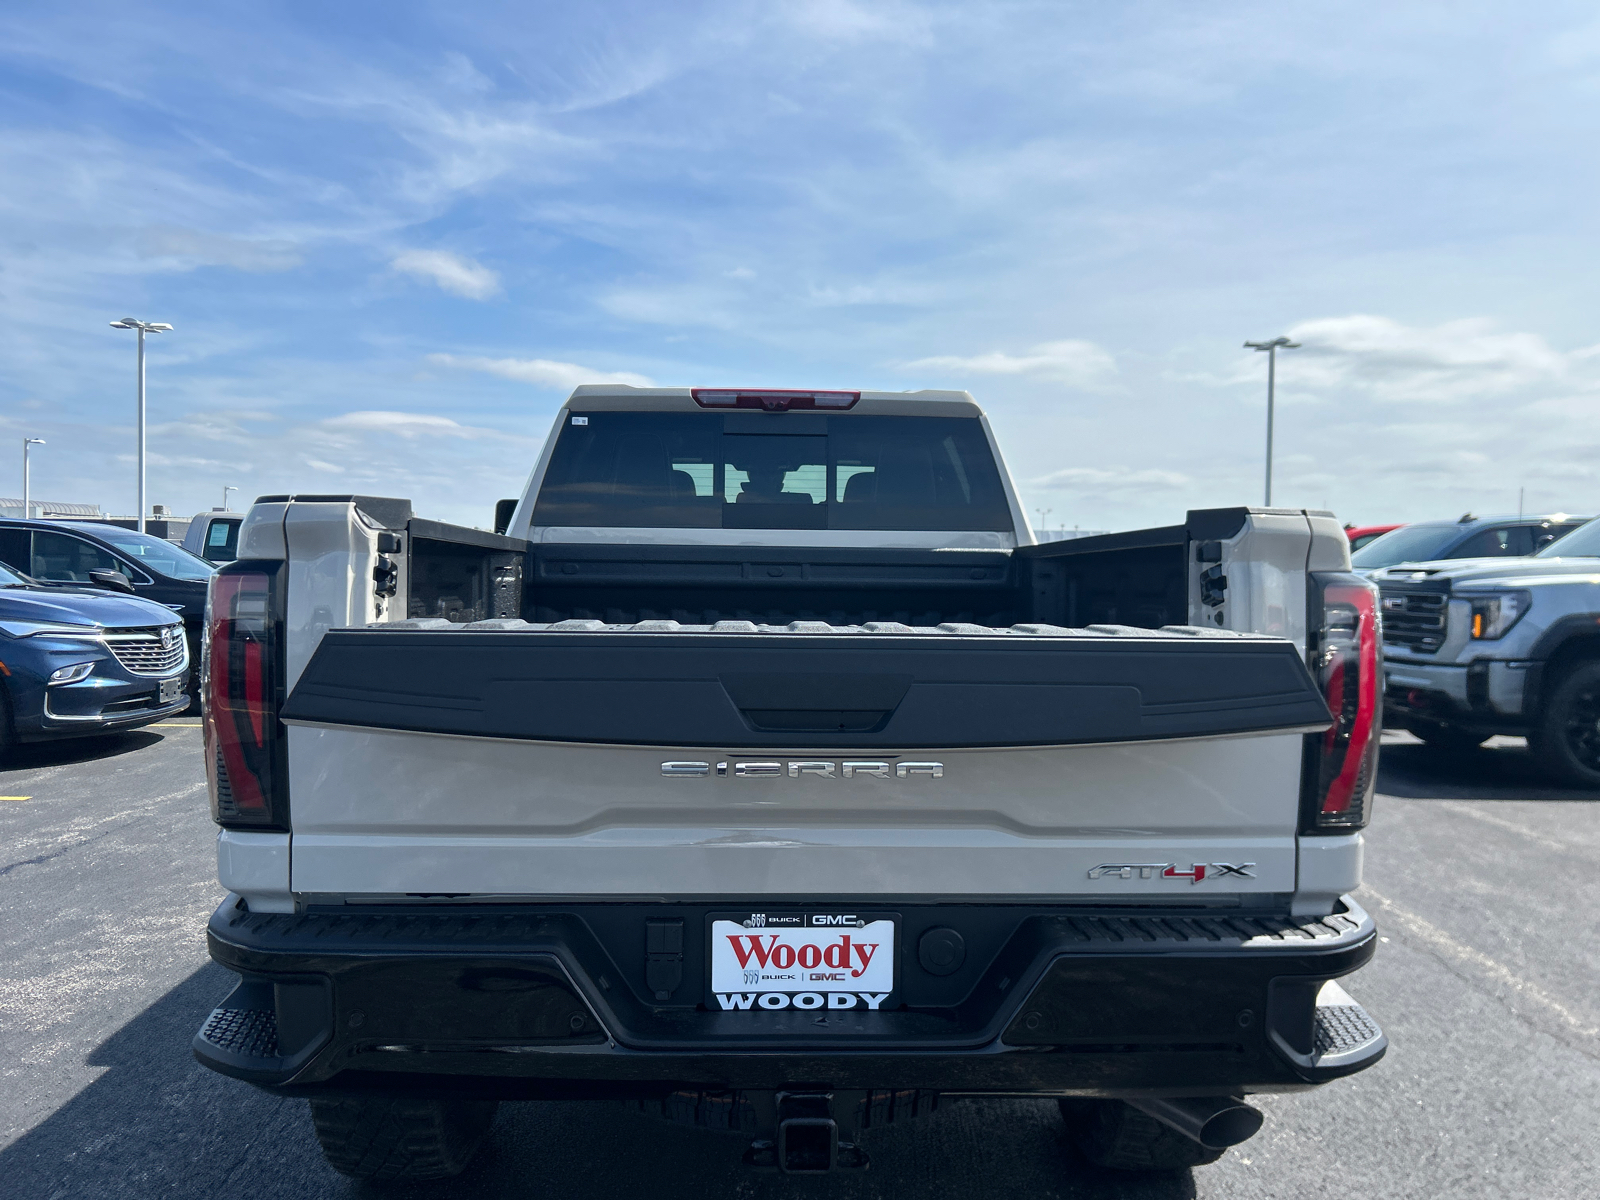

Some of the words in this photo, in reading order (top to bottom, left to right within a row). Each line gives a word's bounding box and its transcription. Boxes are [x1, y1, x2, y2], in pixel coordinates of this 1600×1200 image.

[661, 761, 944, 778] SIERRA
[1088, 862, 1257, 885] AT4X
[812, 915, 857, 925] GMC
[726, 935, 880, 978] Woody
[809, 972, 846, 981] GMC
[716, 992, 890, 1010] WOODY
